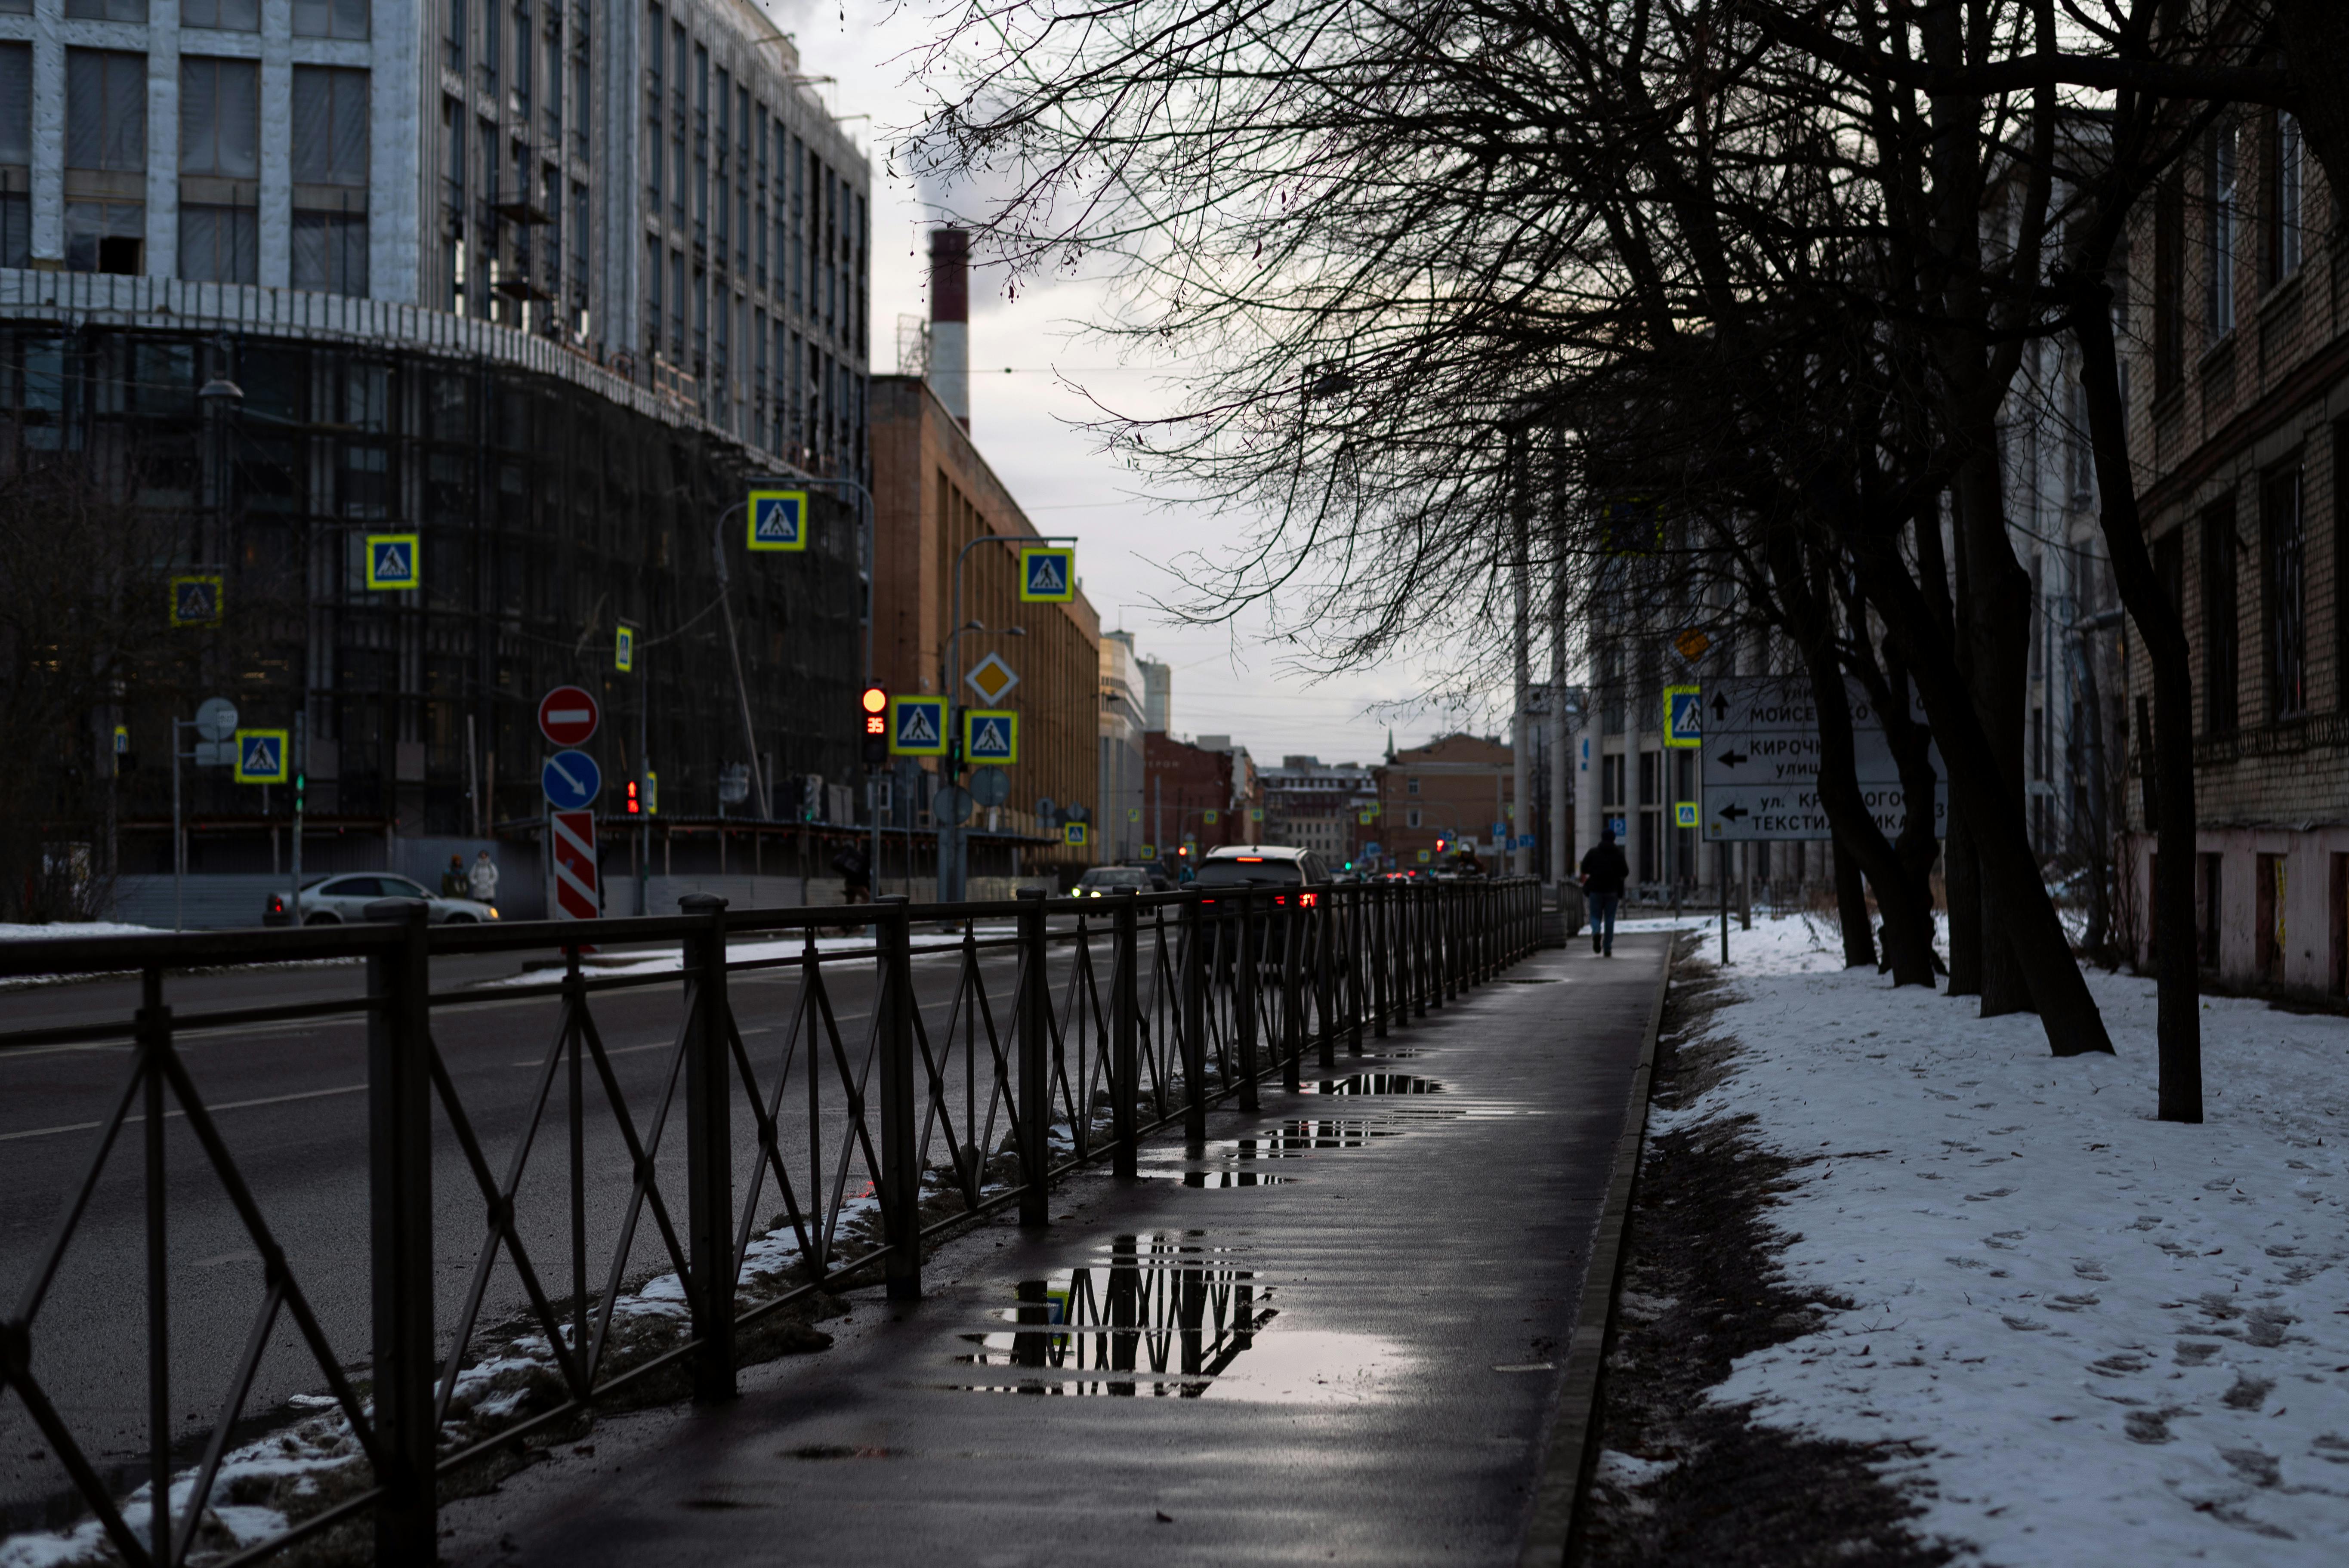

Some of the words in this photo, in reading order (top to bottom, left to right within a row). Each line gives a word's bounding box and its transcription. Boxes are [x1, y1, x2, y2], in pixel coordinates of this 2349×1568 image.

[867, 717, 884, 734] 35
[1776, 763, 1820, 778] улиц
[1761, 796, 1785, 812] ул.
